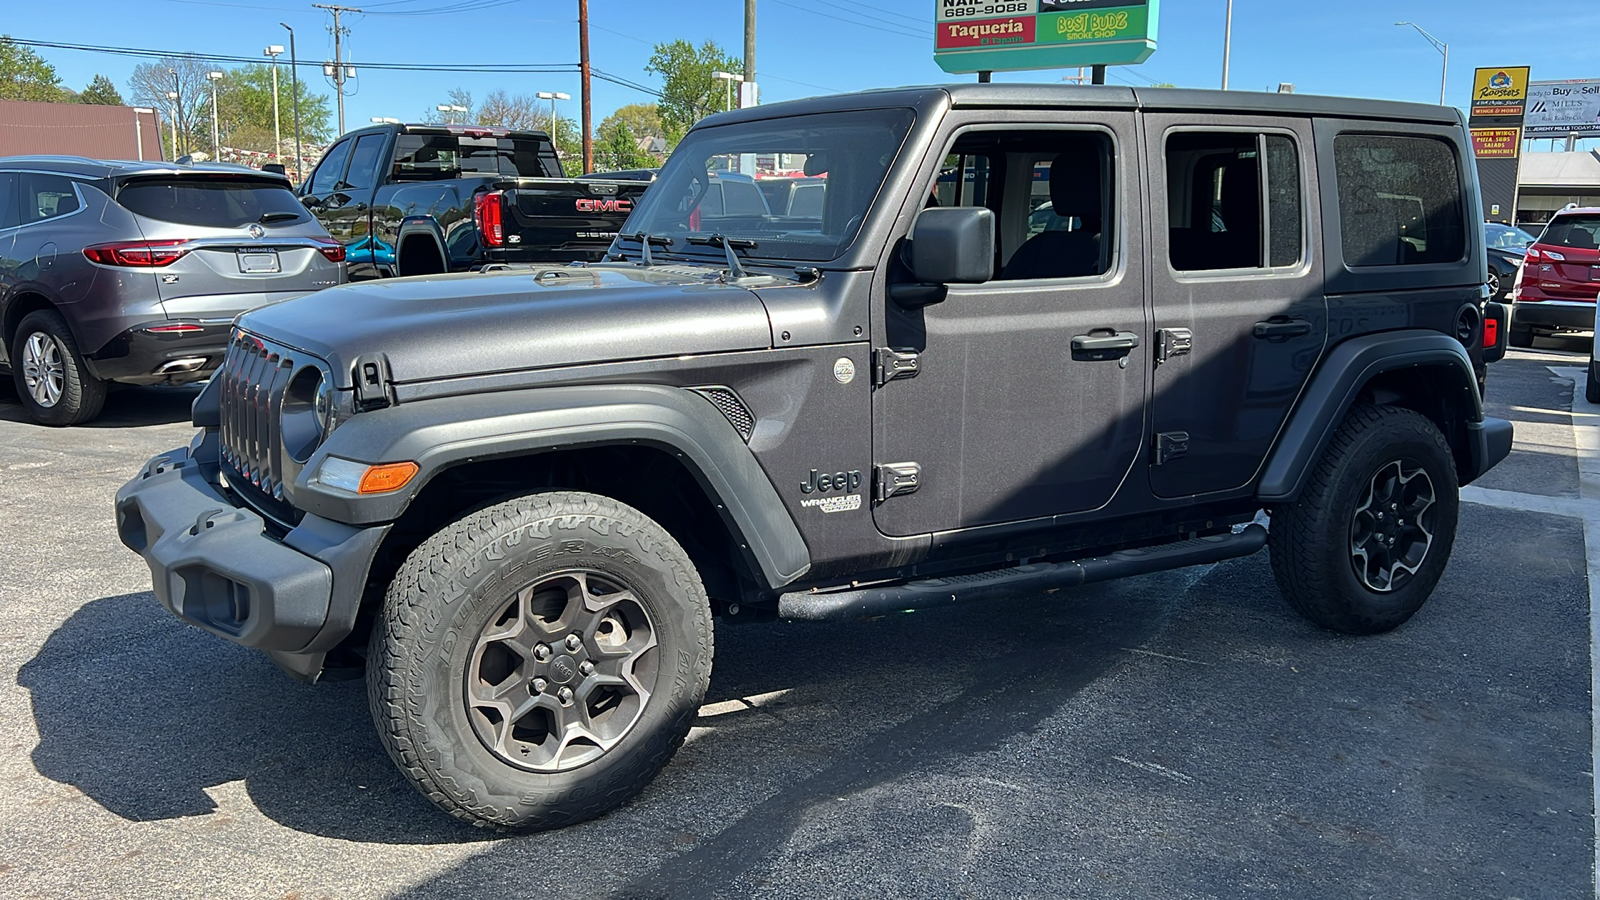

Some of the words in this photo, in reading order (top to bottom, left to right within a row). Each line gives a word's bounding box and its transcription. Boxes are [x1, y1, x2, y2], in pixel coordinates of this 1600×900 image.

[945, 3, 1028, 17] 689-9088
[1066, 31, 1092, 40] SMOKE
[1094, 30, 1116, 38] SHOP
[1479, 87, 1520, 99] Roosters
[1552, 87, 1571, 96] Buy
[1581, 86, 1600, 95] Sell
[575, 199, 631, 211] GMC
[800, 469, 862, 494] Jeep
[800, 495, 861, 508] WRANGLER
[438, 538, 586, 666] DUELER
[592, 545, 641, 566] A/T
[554, 661, 573, 678] Jeep
[519, 648, 691, 807] BRIDGESTONE
